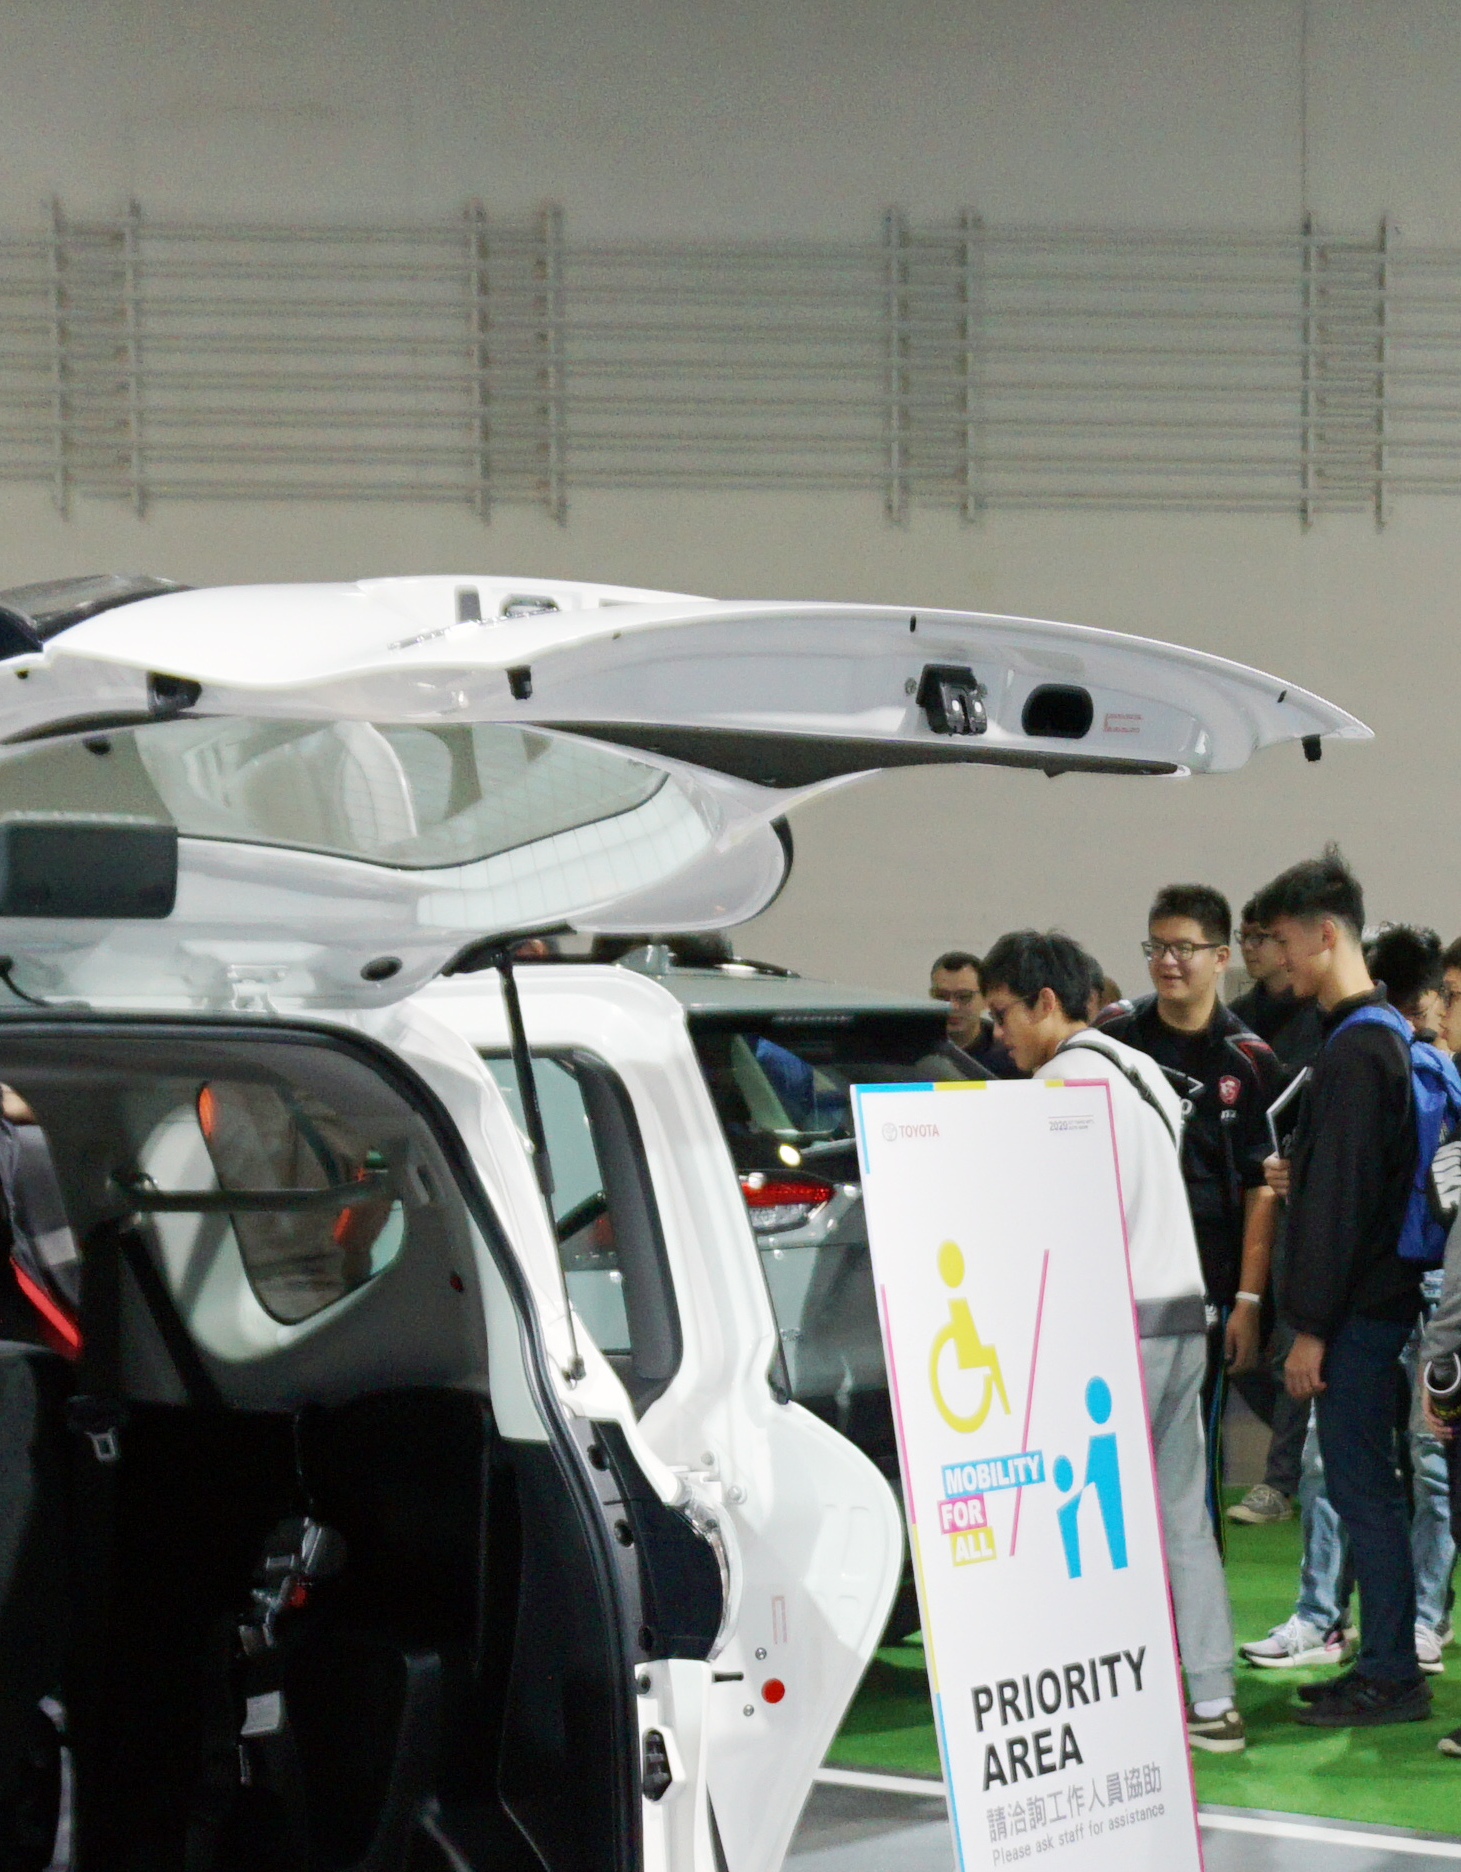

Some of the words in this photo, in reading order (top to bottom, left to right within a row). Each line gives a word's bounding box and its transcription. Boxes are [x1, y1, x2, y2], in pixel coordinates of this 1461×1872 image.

[900, 1124, 940, 1138] TOYOTA
[943, 1454, 1040, 1495] MOBILITY
[940, 1499, 985, 1531] FOR
[954, 1532, 993, 1563] ALL
[970, 1645, 1147, 1733] PRIORITY
[982, 1722, 1085, 1792] AREA
[986, 1761, 1163, 1844] 請洽詢工作人員協助
[992, 1844, 1032, 1867] Please
[1035, 1833, 1055, 1853] ask
[1058, 1822, 1085, 1847] staff
[1088, 1818, 1105, 1837] for
[1108, 1803, 1166, 1831] assistance
